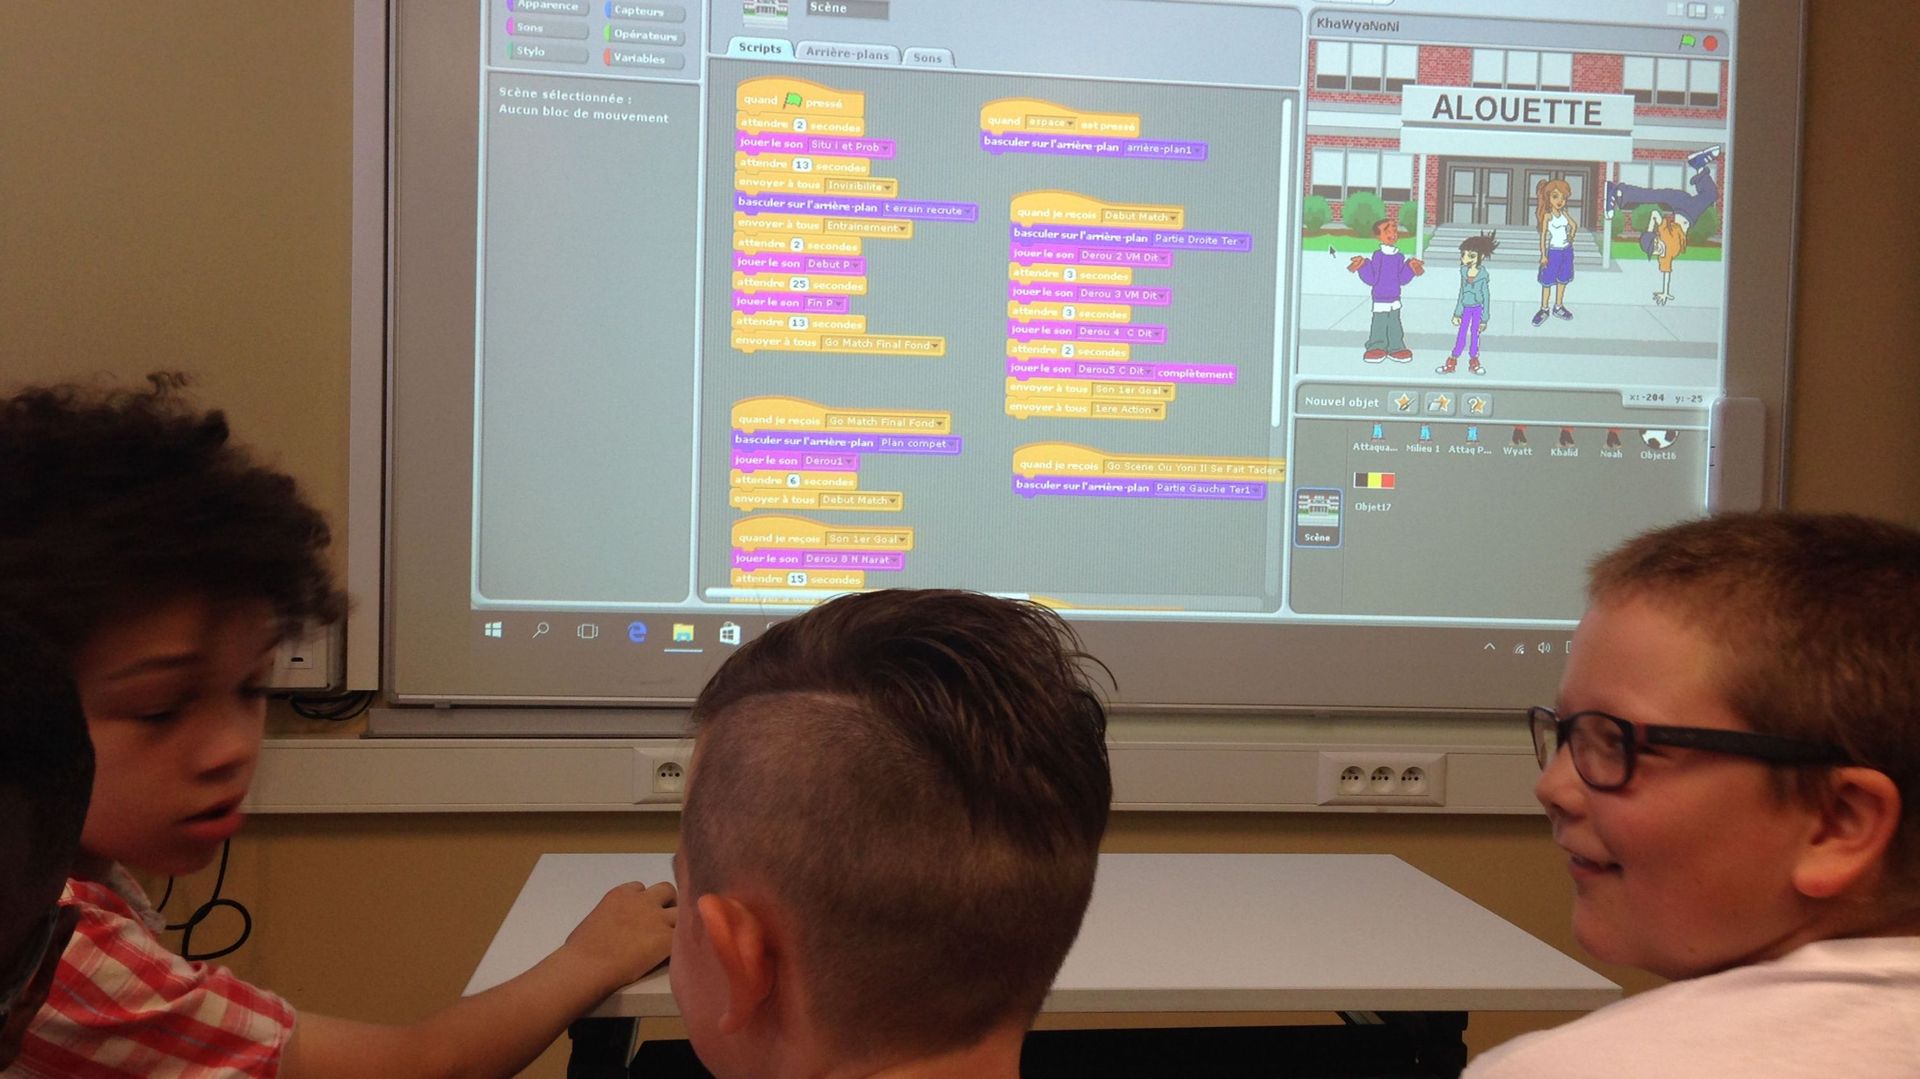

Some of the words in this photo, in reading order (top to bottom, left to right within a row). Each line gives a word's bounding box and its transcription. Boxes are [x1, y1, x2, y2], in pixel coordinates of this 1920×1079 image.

[519, 0, 578, 14] Apparence
[615, 6, 664, 18] Capteurs
[810, 2, 847, 14] Scène
[518, 22, 543, 34] Sons
[615, 30, 677, 44] Opérateurs
[517, 45, 544, 58] Stylo
[740, 43, 782, 56] Scripts
[806, 46, 889, 62] Arrière-plans
[614, 54, 665, 65] Variables
[914, 53, 942, 64] Sons
[500, 88, 537, 99] Scène
[543, 88, 623, 104] sélectionnée
[500, 105, 538, 116] Aucun
[543, 106, 568, 117] bloc
[594, 111, 668, 124] mouvement
[1433, 94, 1602, 126] ALOUETTE
[741, 119, 788, 128] attendre
[811, 122, 860, 132] secondes
[984, 137, 1030, 148] basculer
[1032, 140, 1049, 148] sur
[740, 159, 787, 168] attendre
[816, 163, 866, 172] secondes
[739, 197, 786, 208] basculer
[927, 206, 962, 215] recrute
[739, 220, 783, 230] envoyer
[797, 222, 819, 230] tous
[828, 222, 898, 232] Entrainement
[1014, 229, 1059, 240] basculer
[1061, 232, 1078, 240] sur
[1156, 234, 1184, 244] Partie
[1188, 236, 1218, 245] Droite
[1222, 237, 1237, 246] Ter
[738, 239, 785, 248] attendre
[808, 242, 857, 251] secondes
[1014, 249, 1043, 259] jouer
[1045, 250, 1054, 258] le
[1058, 251, 1073, 259] son
[1082, 252, 1110, 260] Derou
[1144, 254, 1158, 262] Dit
[738, 258, 767, 269] jouer
[769, 258, 778, 267] le
[809, 260, 840, 268] Debut
[1014, 269, 1059, 278] attendre
[1080, 271, 1128, 280] secondes
[738, 278, 784, 287] attendre
[813, 282, 863, 290] secondes
[1013, 288, 1042, 297] jouer
[1043, 288, 1053, 296] le
[1081, 290, 1109, 298] Derou
[1143, 292, 1157, 300] Dit
[737, 297, 766, 307] jouer
[768, 298, 777, 306] le
[808, 299, 822, 307] Fin
[1012, 326, 1041, 335] jouer
[1080, 328, 1110, 336] Derou
[1138, 329, 1152, 337] Dit
[1012, 346, 1057, 354] attendre
[1078, 348, 1127, 356] secondes
[1011, 364, 1040, 373] jouer
[1042, 364, 1051, 372] le
[1130, 367, 1144, 375] Dit
[1158, 369, 1233, 381] complètement
[1305, 396, 1345, 407] Nouvel
[1349, 396, 1379, 409] objet
[739, 416, 772, 425] quand
[776, 417, 785, 425] je
[789, 417, 820, 426] reçois
[848, 418, 877, 426] Match
[881, 419, 905, 427] Final
[736, 435, 782, 445] basculer
[882, 439, 904, 447] Plan
[909, 440, 946, 449] compet
[1406, 443, 1432, 453] Milieu
[1449, 445, 1474, 455] Attaq
[1504, 446, 1532, 456] Wyatt
[1551, 447, 1578, 457] Khalid
[735, 456, 765, 465] jouer
[767, 456, 776, 464] le
[780, 457, 797, 465] son
[1020, 461, 1052, 470] quand
[1054, 461, 1064, 470] je
[1067, 462, 1098, 471] reçois
[1125, 462, 1153, 471] Scene
[1227, 465, 1244, 473] Fait
[736, 476, 782, 484] attendre
[804, 478, 853, 486] secondes
[1016, 480, 1061, 490] basculer
[1157, 484, 1185, 493] Partie
[1189, 485, 1225, 493] Gauche
[1230, 486, 1250, 494] Ter1
[1355, 502, 1391, 512] Objet17
[1305, 533, 1330, 542] Scène
[736, 575, 783, 583] attendre
[811, 576, 860, 584] secondes
